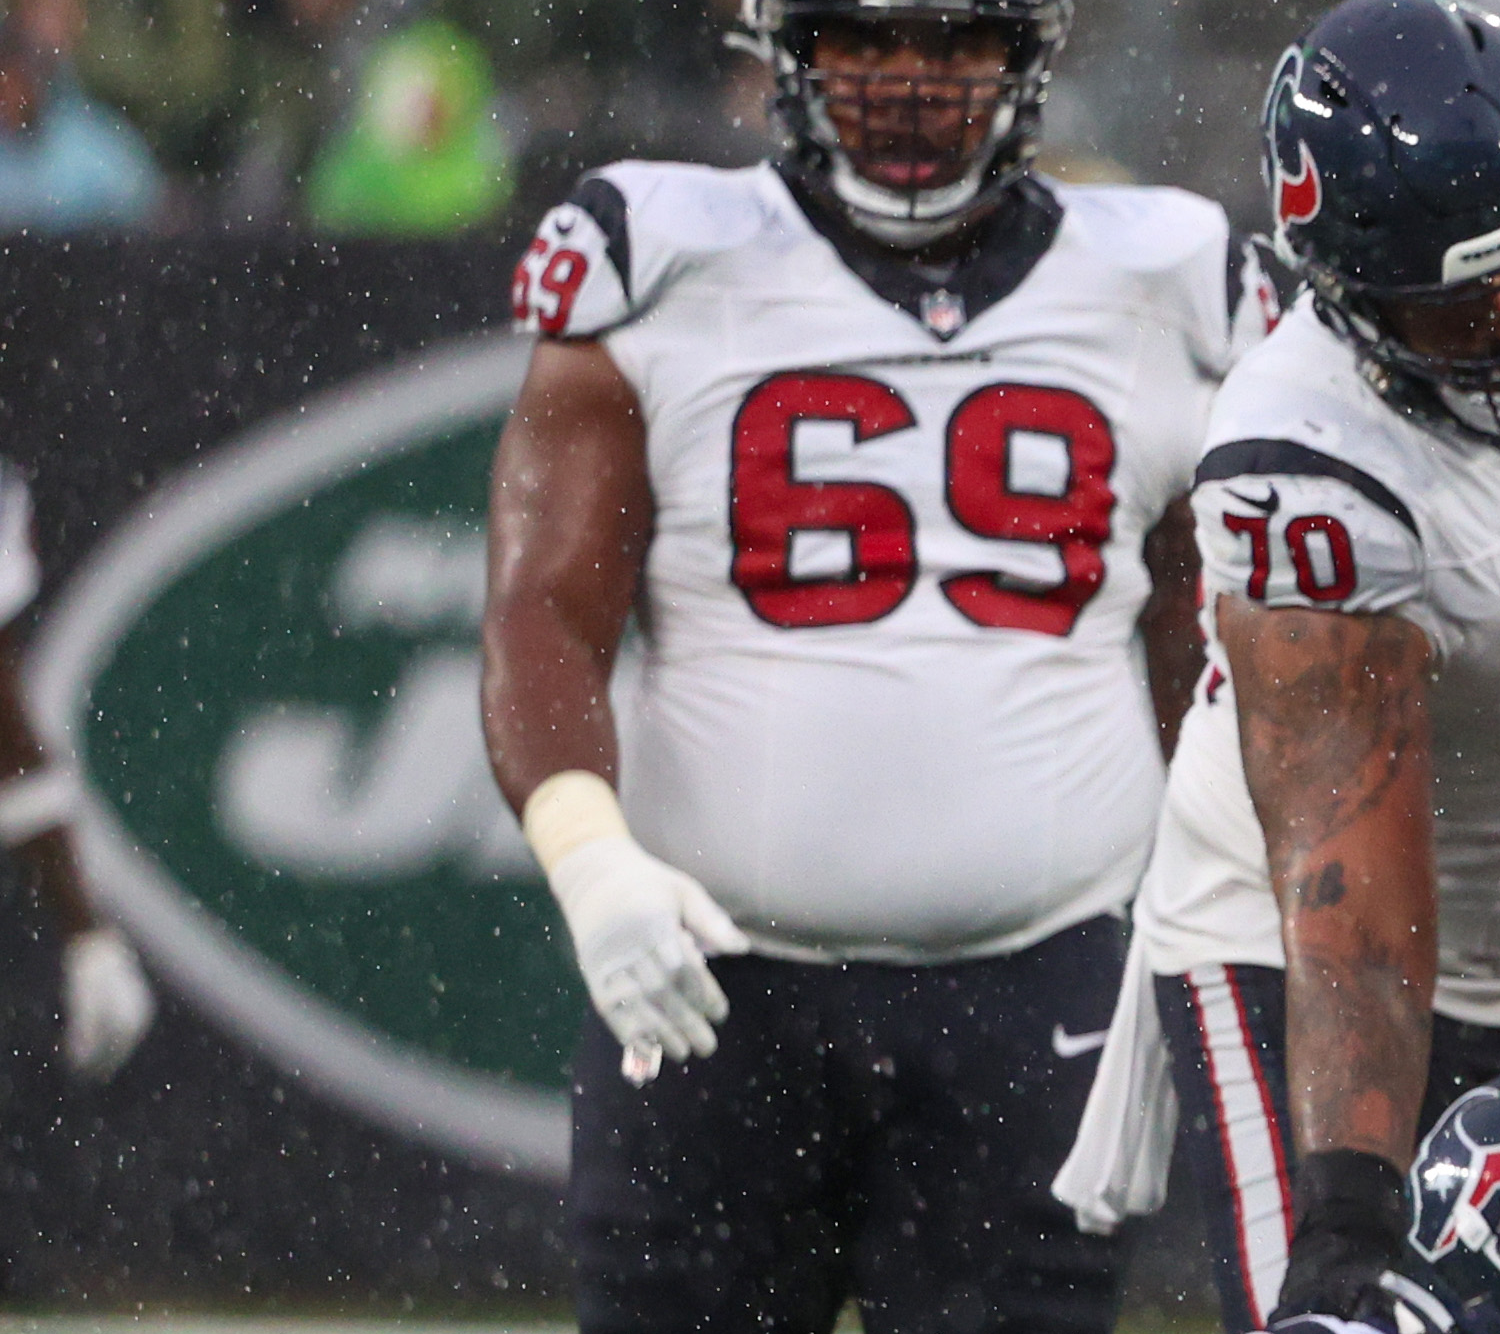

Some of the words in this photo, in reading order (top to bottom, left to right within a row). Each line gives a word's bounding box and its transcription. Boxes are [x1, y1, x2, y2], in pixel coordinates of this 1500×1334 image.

[511, 237, 588, 337] 69
[730, 370, 1117, 637] 69
[1222, 512, 1357, 603] 70
